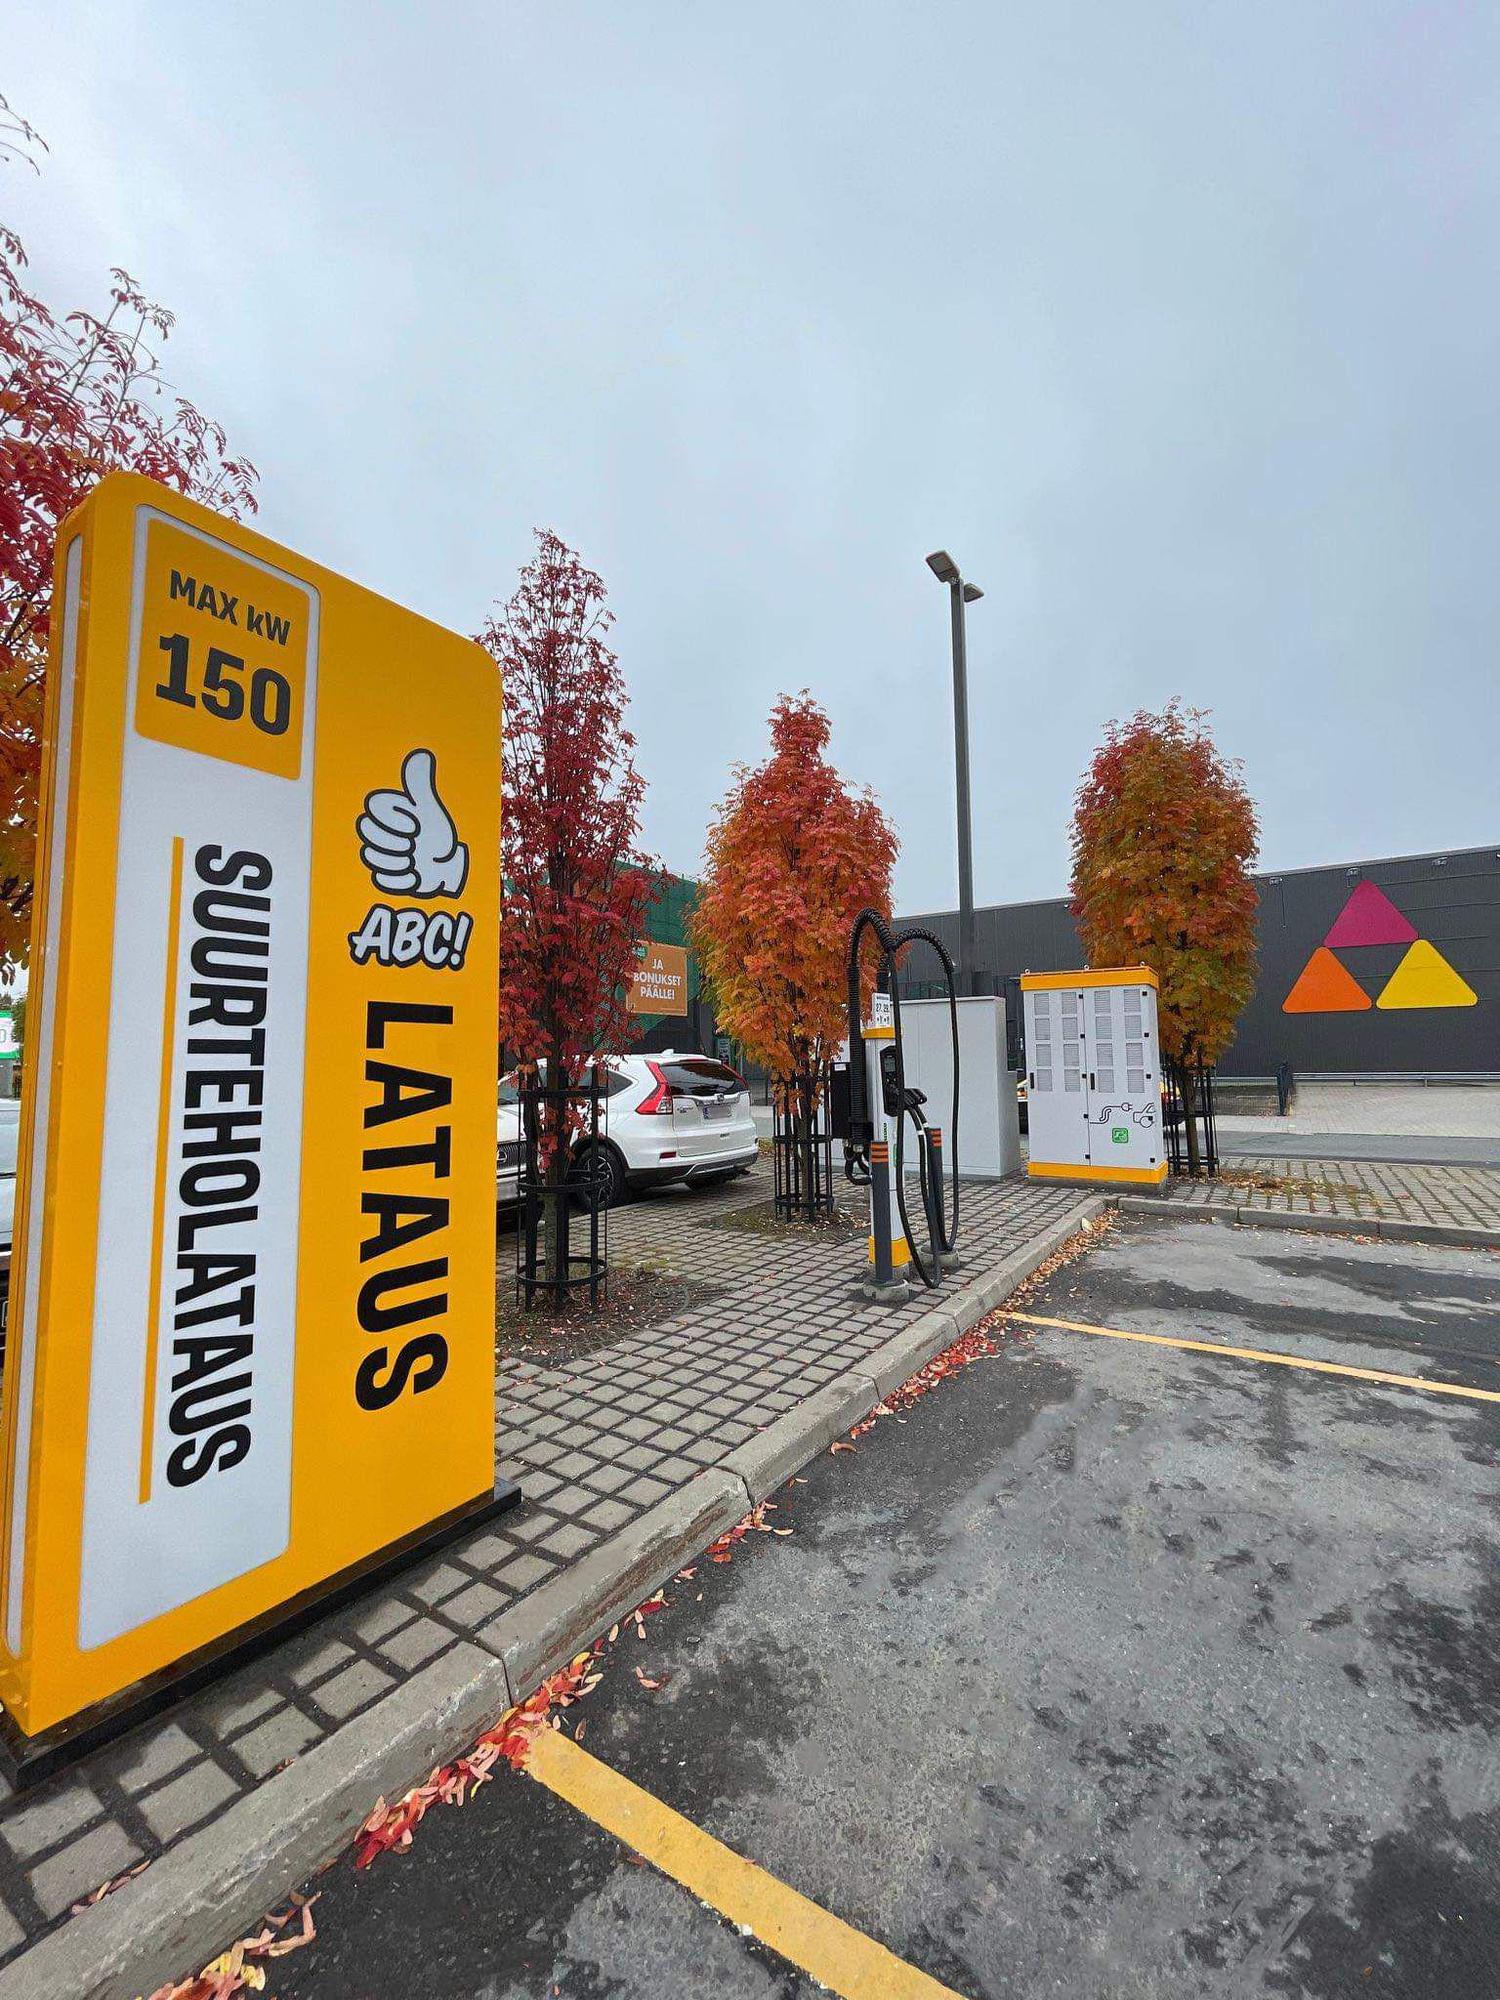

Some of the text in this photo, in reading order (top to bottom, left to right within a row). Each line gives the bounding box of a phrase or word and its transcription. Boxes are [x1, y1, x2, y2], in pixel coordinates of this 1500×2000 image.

[170, 569, 292, 646] MAX kW
[155, 632, 291, 736] 150
[348, 904, 474, 971] ABC!
[652, 958, 664, 970] JA
[633, 972, 682, 986] BONUKSET
[640, 984, 675, 1000] PÄÄLLE!
[166, 844, 273, 1488] SUURTEHOLATAUS
[355, 1000, 454, 1411] LATAUS
